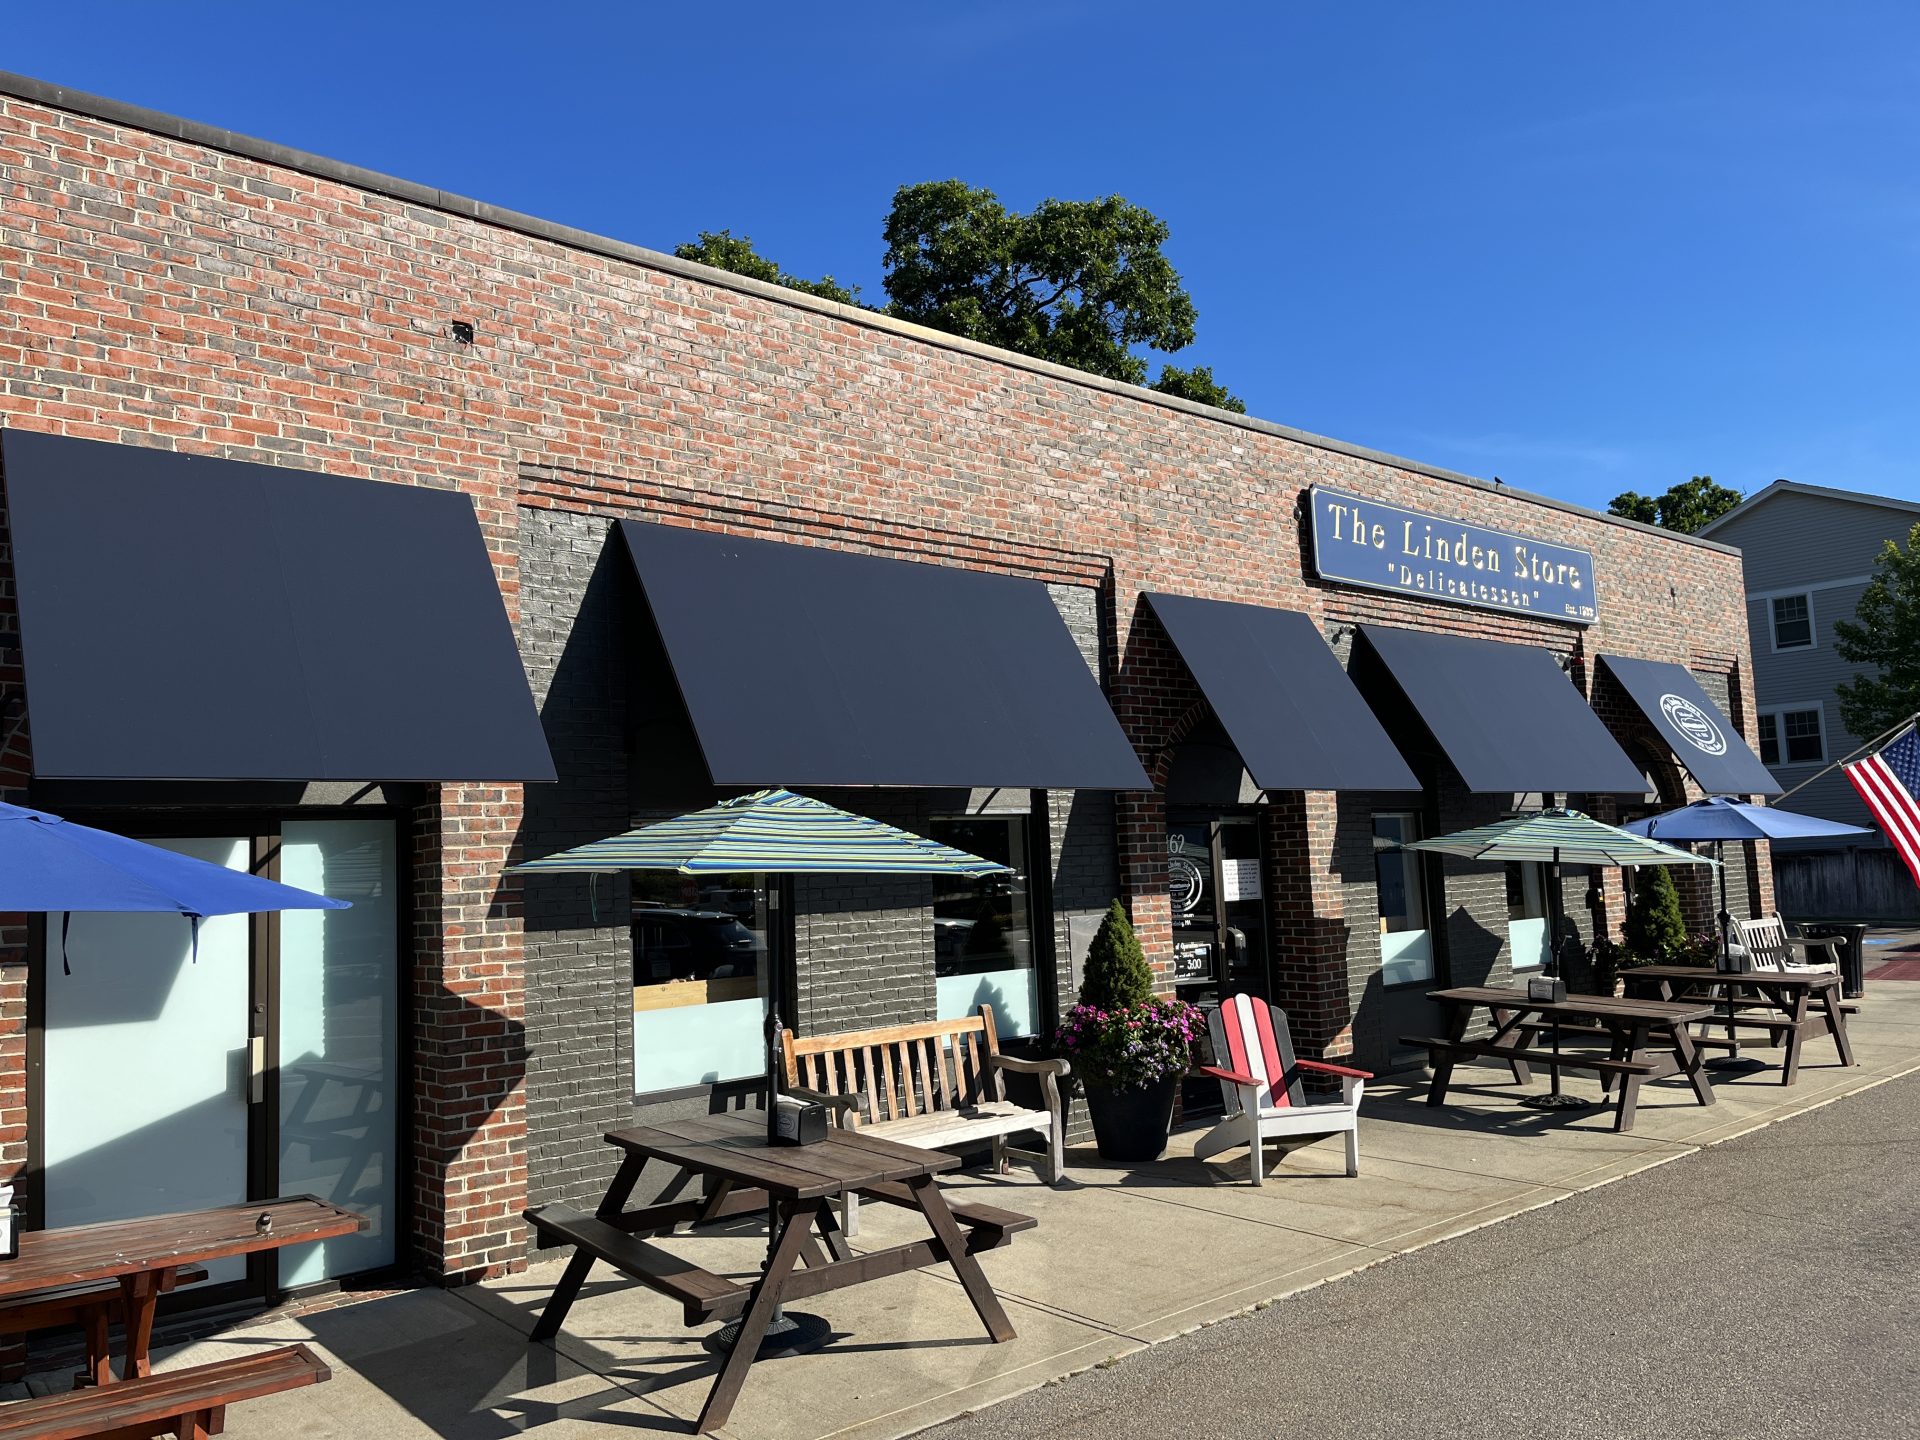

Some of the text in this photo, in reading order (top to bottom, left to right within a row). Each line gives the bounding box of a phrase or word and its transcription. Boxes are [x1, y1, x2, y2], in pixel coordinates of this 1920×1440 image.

[1328, 504, 1581, 590] The Linden Store
[1388, 562, 1540, 607] "Delicatessen"
